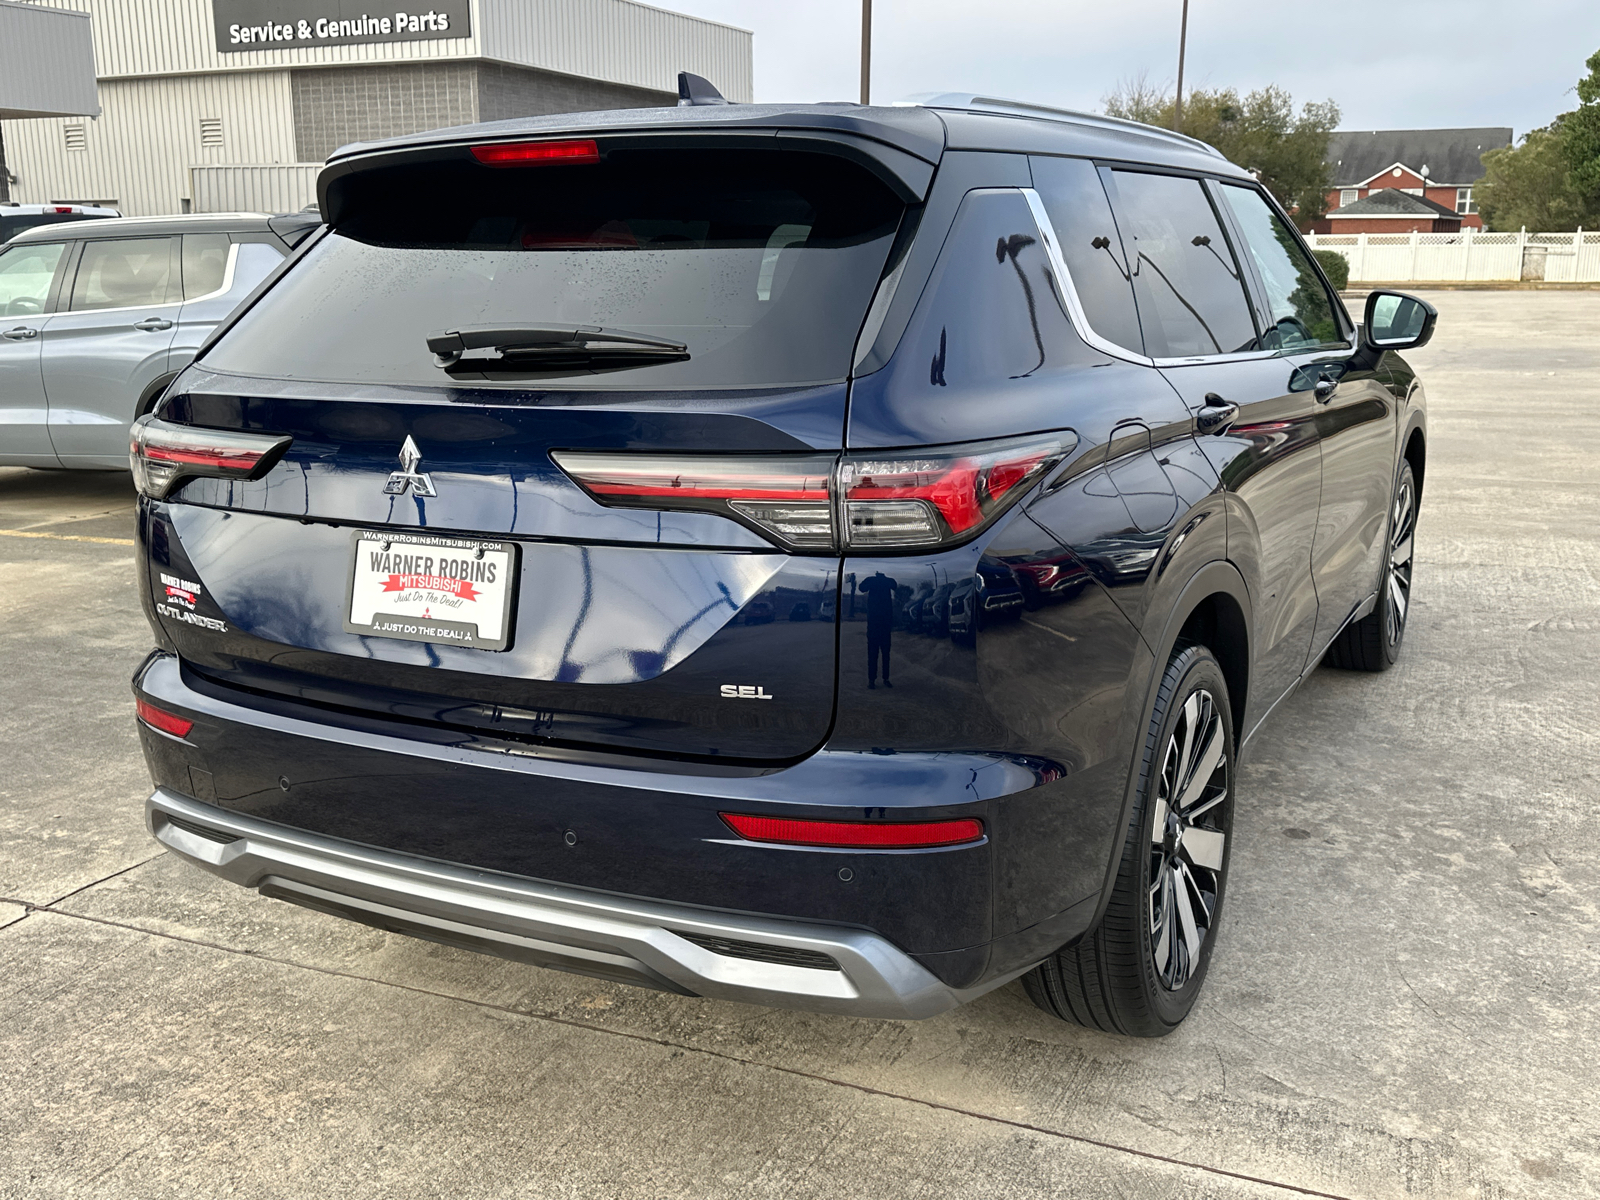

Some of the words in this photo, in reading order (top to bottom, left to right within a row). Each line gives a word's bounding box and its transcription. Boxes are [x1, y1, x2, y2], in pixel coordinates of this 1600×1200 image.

[229, 21, 294, 44] Service
[297, 19, 313, 39] &
[315, 14, 391, 39] Genuine
[395, 10, 450, 33] Parts
[370, 551, 434, 576] WARNER
[439, 558, 497, 584] ROBINS
[399, 575, 462, 593] MITSUBISHI
[394, 591, 412, 603] Just
[413, 591, 423, 602] Do
[426, 592, 439, 603] The
[439, 595, 464, 609] Deal!
[157, 603, 228, 632] OUTLANDER
[381, 622, 403, 632] JUST
[404, 624, 417, 634] DO
[418, 626, 436, 637] THE
[437, 628, 464, 640] DEAL!
[720, 684, 773, 700] SEL
